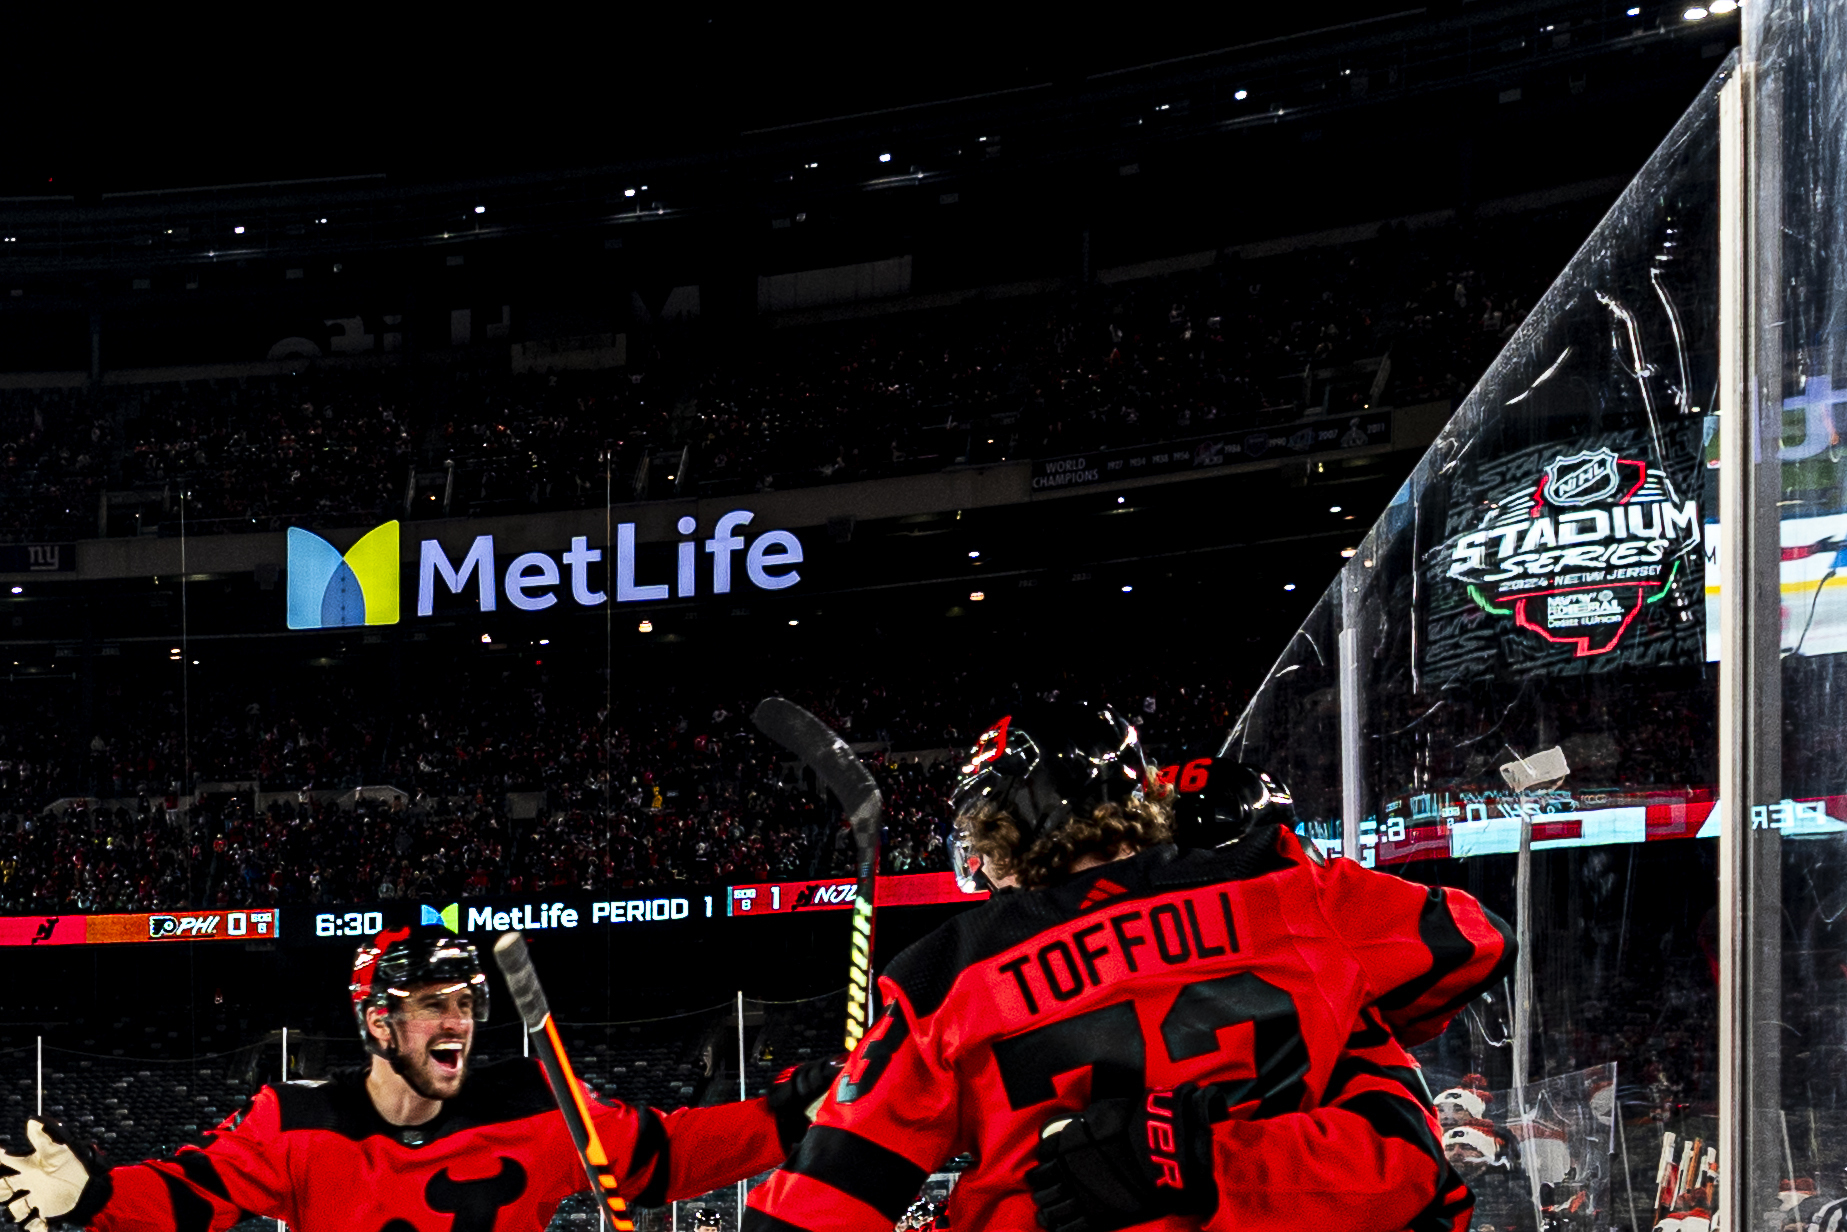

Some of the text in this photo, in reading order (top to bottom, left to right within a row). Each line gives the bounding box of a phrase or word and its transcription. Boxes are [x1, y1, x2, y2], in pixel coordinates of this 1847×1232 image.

[1033, 468, 1099, 488] CHAMPIONS
[1046, 458, 1086, 474] WORLD
[1450, 501, 1700, 578] STADIUM
[418, 510, 803, 616] MetLife
[1483, 540, 1669, 582] SERIES
[1606, 564, 1662, 580] JERSEY
[770, 886, 780, 910] 1
[228, 912, 247, 936] 0
[315, 912, 382, 936] 6:30
[468, 896, 713, 932] MetLife PERIOD 1
[998, 892, 1241, 1017] TOFFOLI
